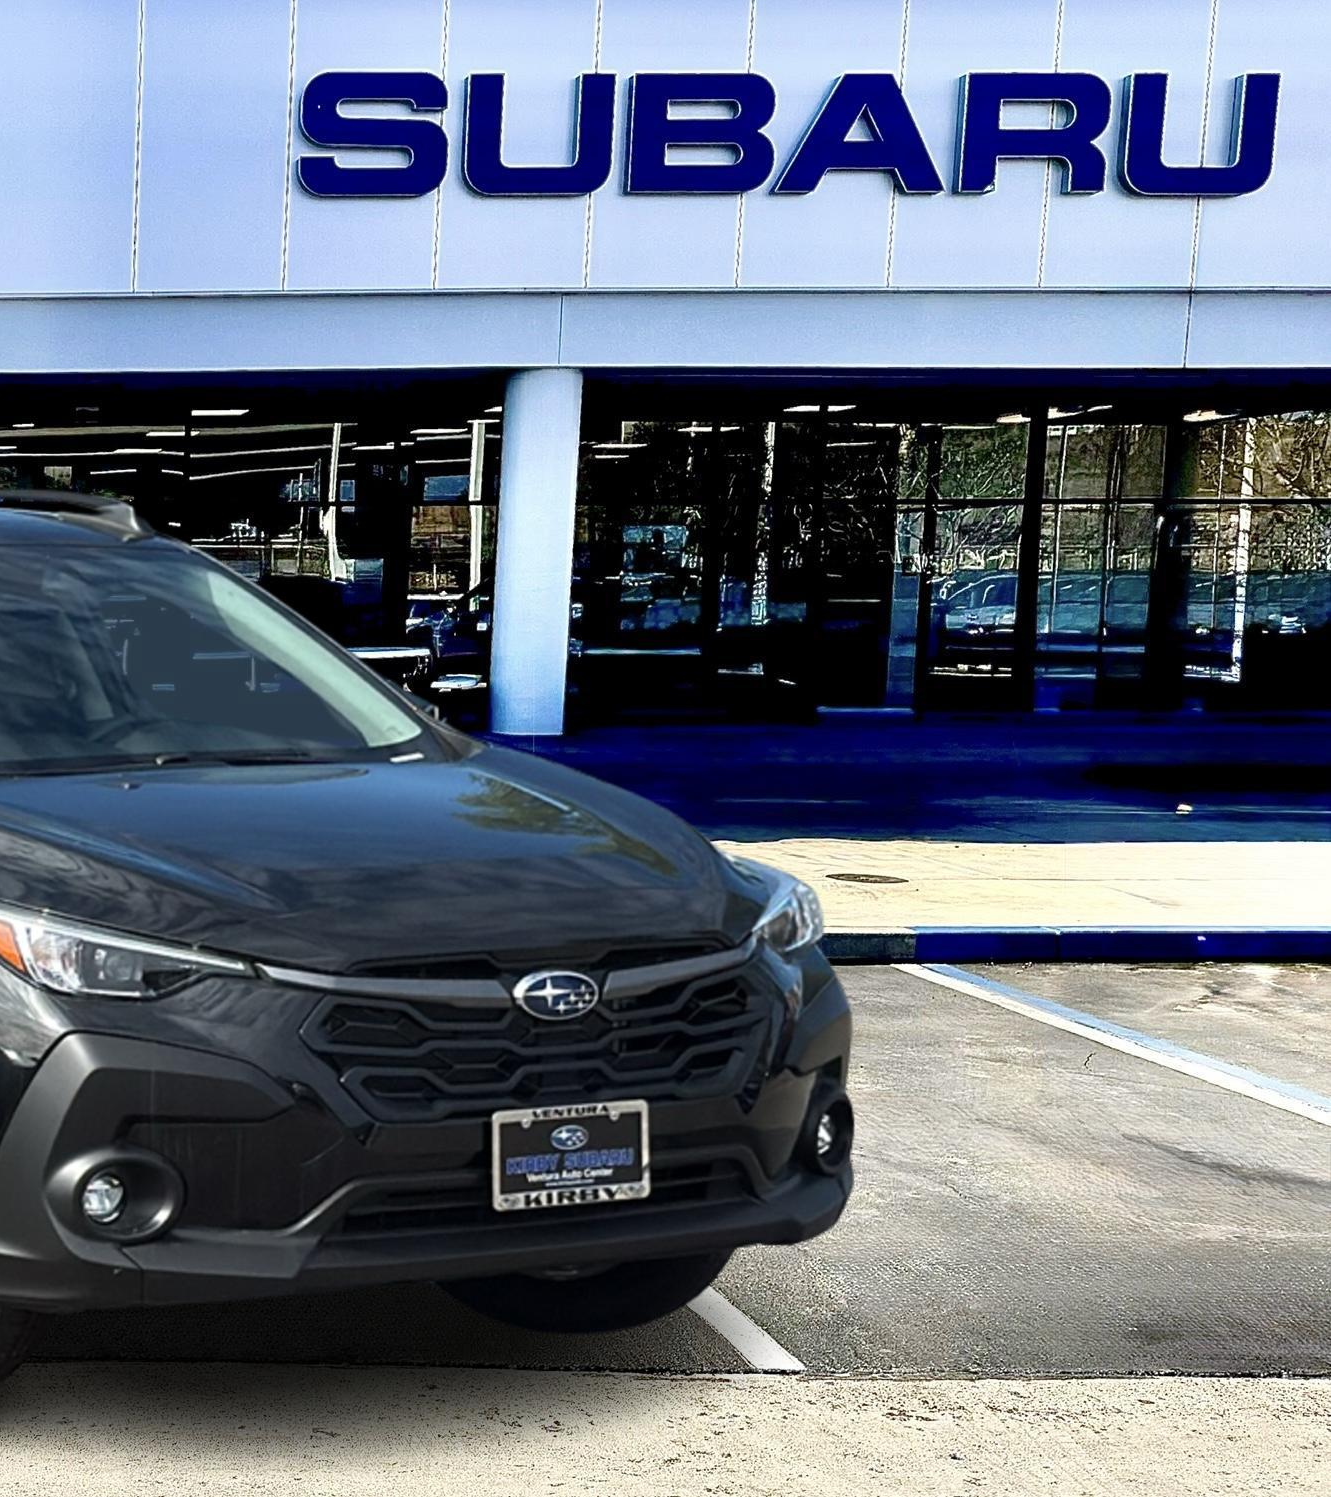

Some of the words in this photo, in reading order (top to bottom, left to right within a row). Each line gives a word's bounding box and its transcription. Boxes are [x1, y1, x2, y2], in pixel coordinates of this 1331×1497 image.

[297, 70, 1281, 198] SUBARU
[532, 1104, 609, 1119] VENTURA
[506, 1155, 559, 1175] KIRBY
[564, 1147, 634, 1169] SUBARU
[526, 1172, 559, 1182] Ventura
[561, 1169, 583, 1179] Auto
[584, 1167, 614, 1177] Center
[524, 1187, 620, 1207] KIRBY
